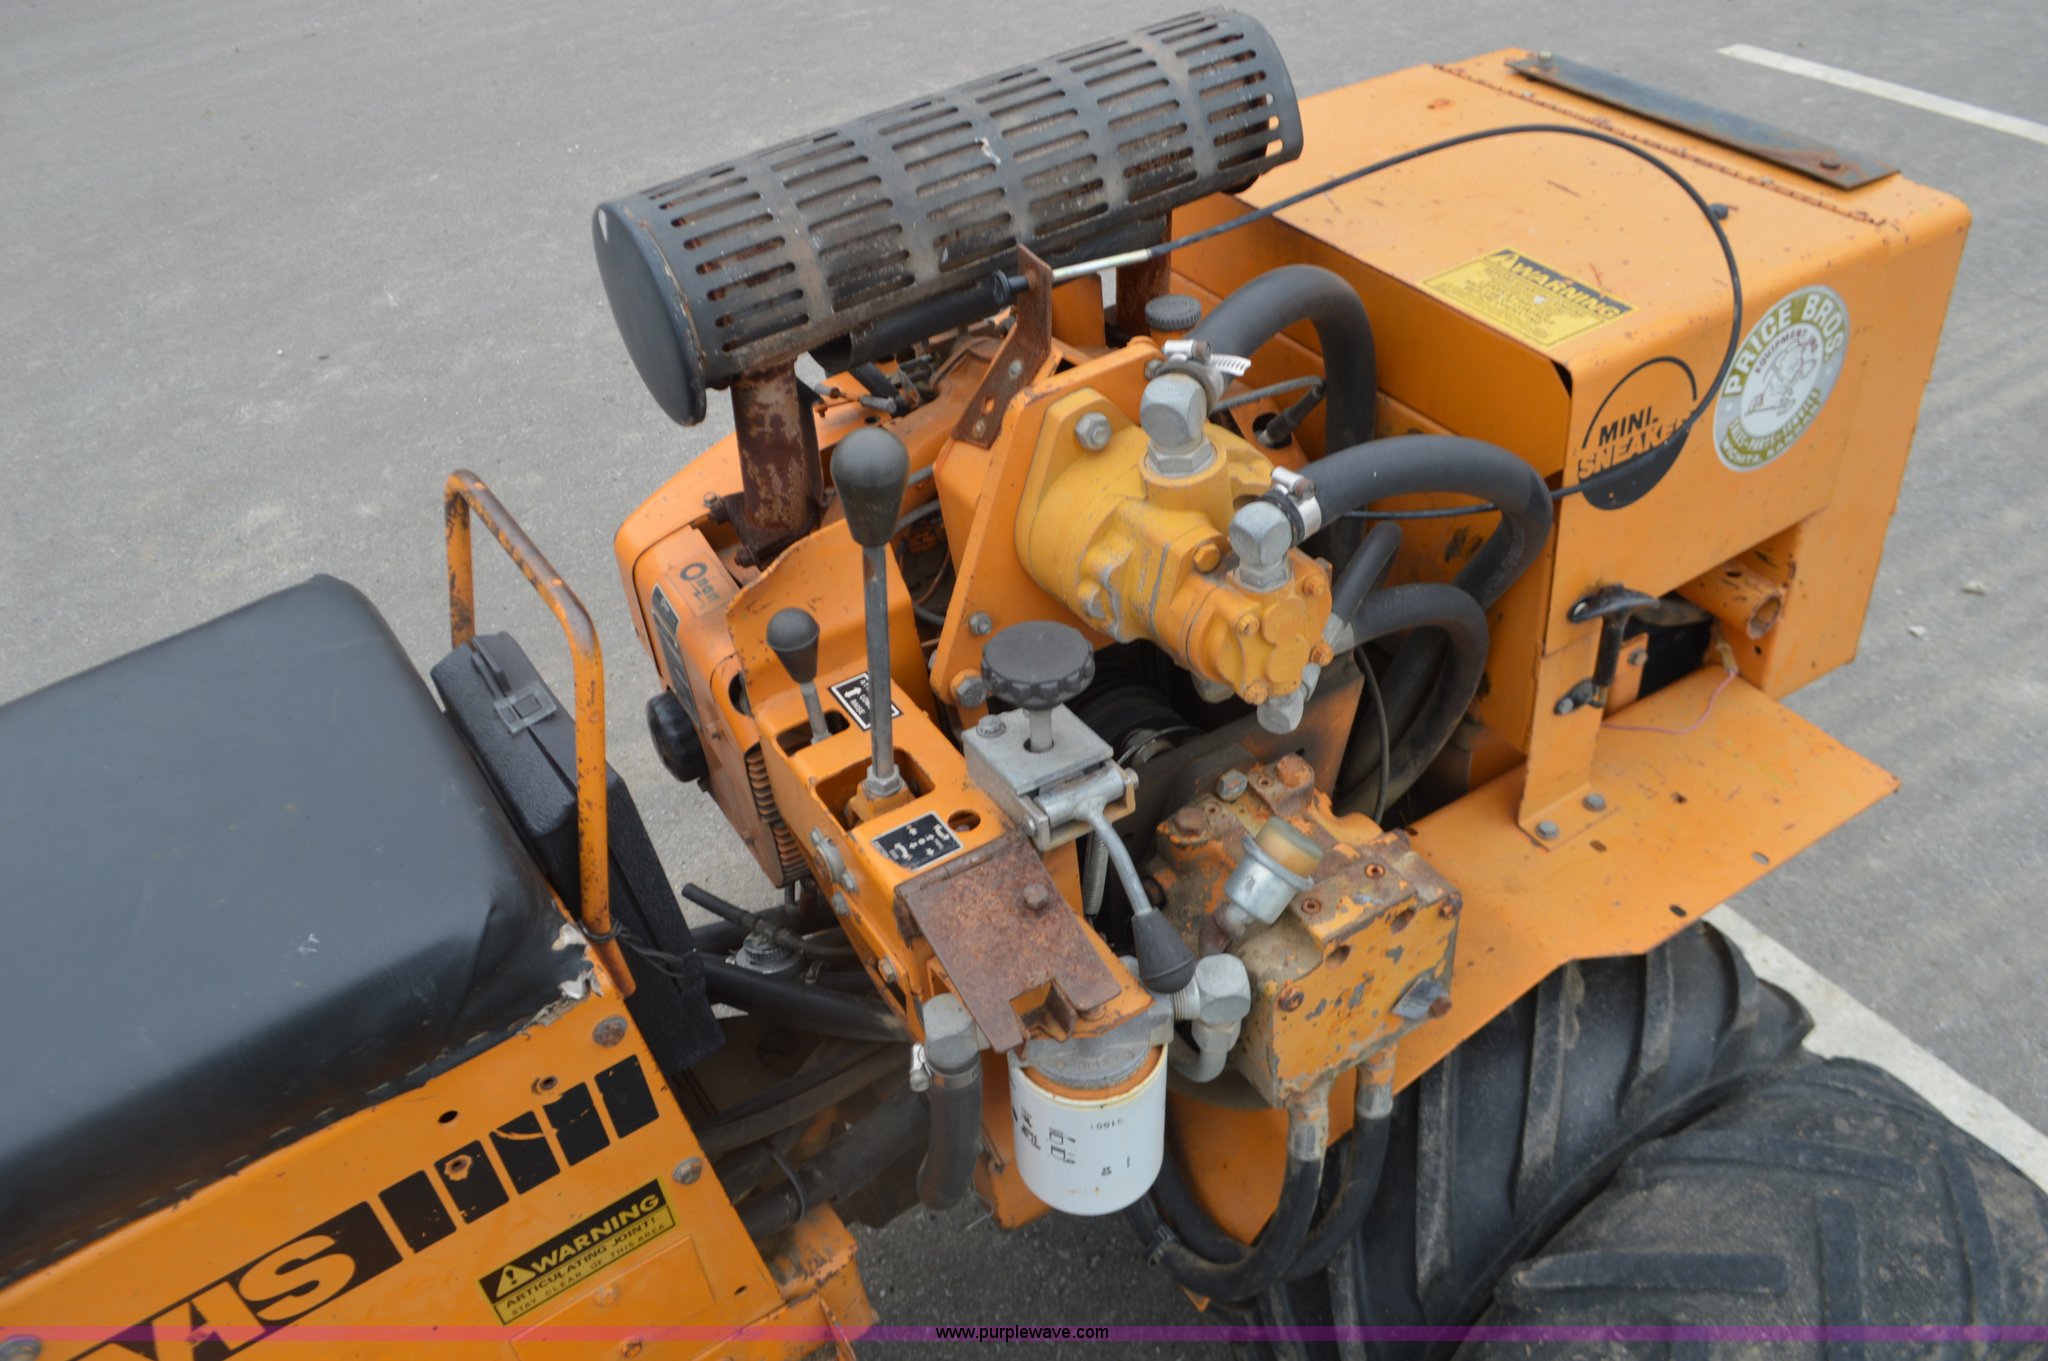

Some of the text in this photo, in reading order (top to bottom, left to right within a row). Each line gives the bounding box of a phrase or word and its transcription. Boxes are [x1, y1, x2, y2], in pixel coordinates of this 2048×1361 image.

[1512, 262, 1621, 318] WARNING
[1724, 301, 1792, 396] PRICE
[1755, 329, 1807, 374] EQUIPMENT
[507, 1217, 656, 1308] ARTICULATING JOINT!
[512, 1224, 665, 1316] STAY CLEAR OF THIS AREA
[531, 1194, 659, 1273] WARNING
